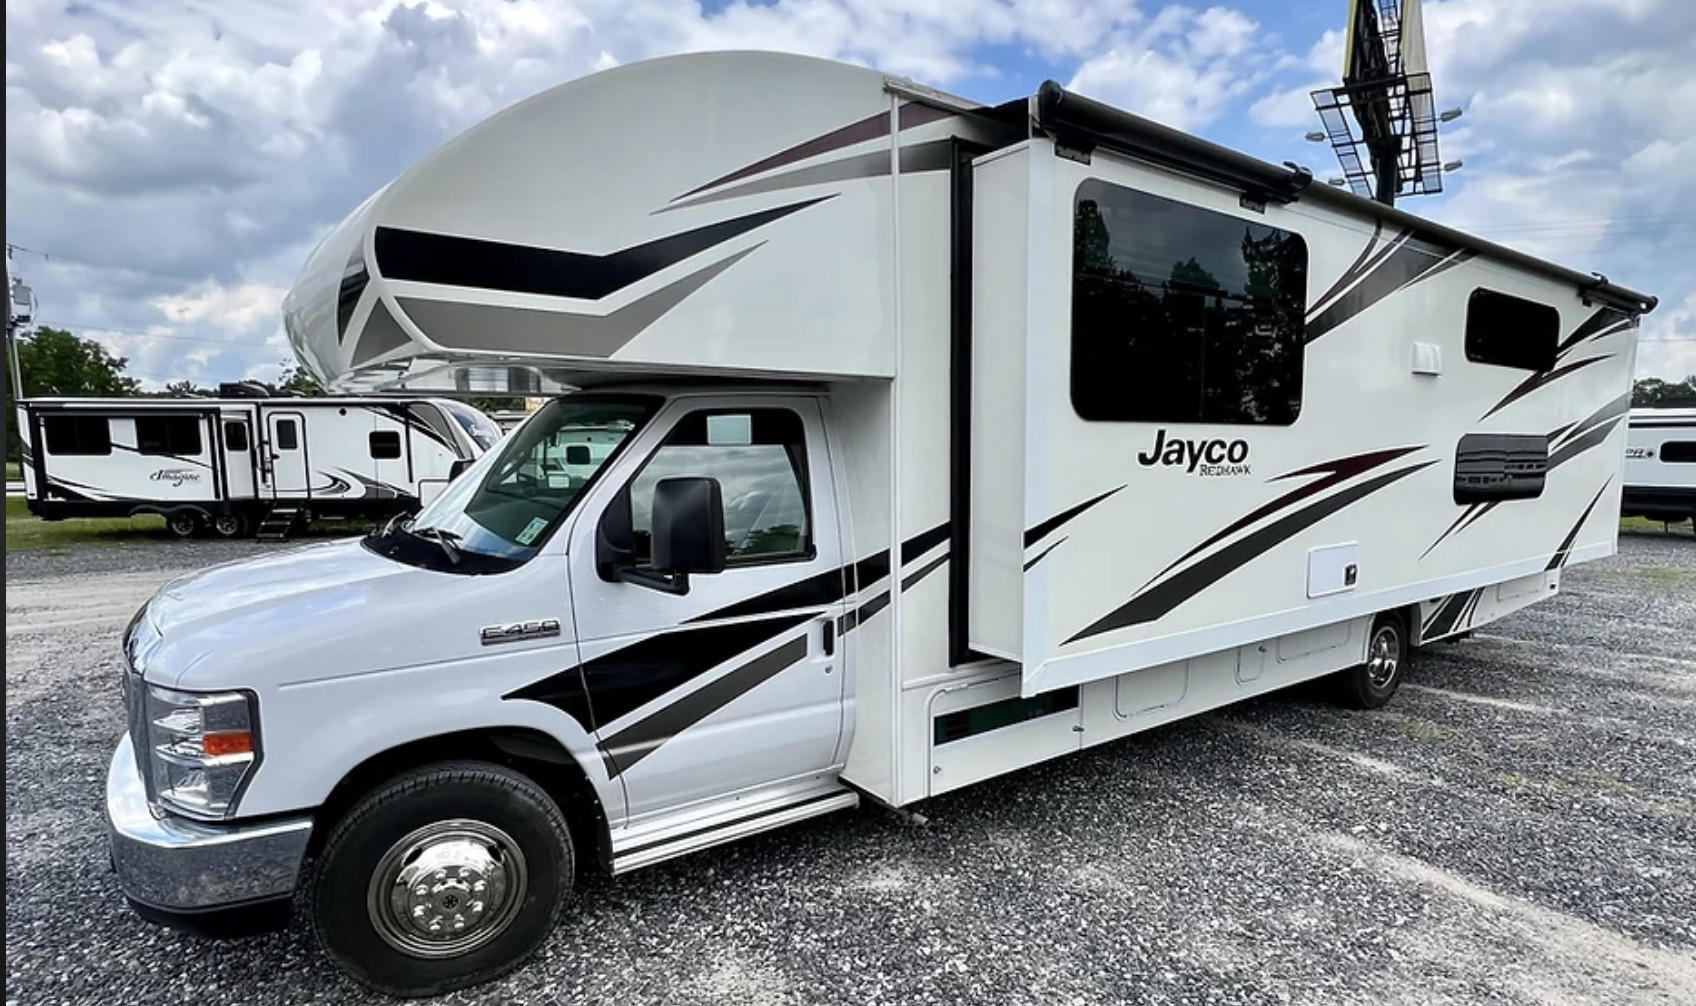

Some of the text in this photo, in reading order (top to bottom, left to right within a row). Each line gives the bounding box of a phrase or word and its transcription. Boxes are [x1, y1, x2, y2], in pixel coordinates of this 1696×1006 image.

[1138, 429, 1249, 473] Jayco
[149, 469, 200, 487] Imagine
[1200, 464, 1251, 477] REDHAWK
